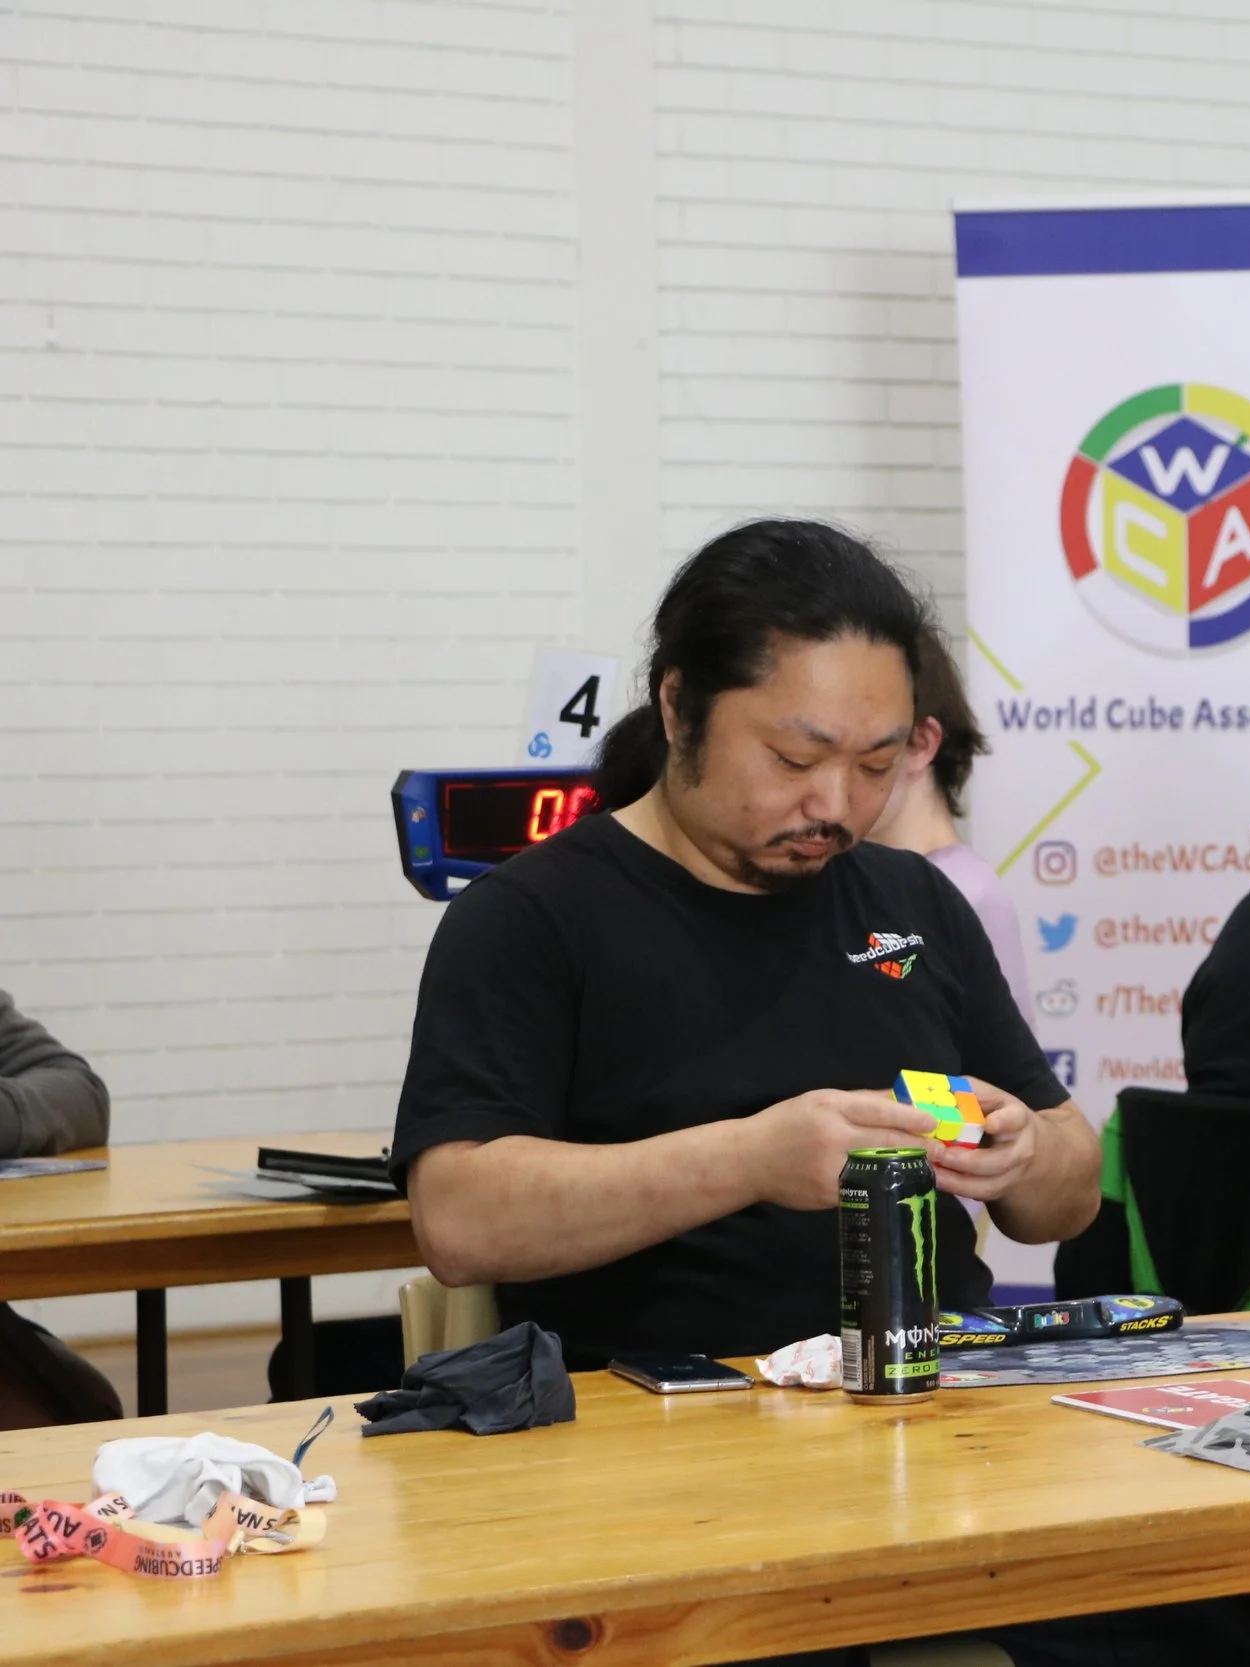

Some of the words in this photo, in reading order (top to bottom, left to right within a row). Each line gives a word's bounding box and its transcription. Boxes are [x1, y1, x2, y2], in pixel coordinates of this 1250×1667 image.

[1138, 445, 1231, 496] W
[559, 675, 600, 738] 4
[997, 696, 1096, 730] World
[1106, 697, 1184, 730] Cube
[1094, 915, 1218, 948] @theWC
[905, 1348, 939, 1360] ENE
[939, 1333, 1006, 1346] SPEED
[888, 1364, 931, 1375] ZERO
